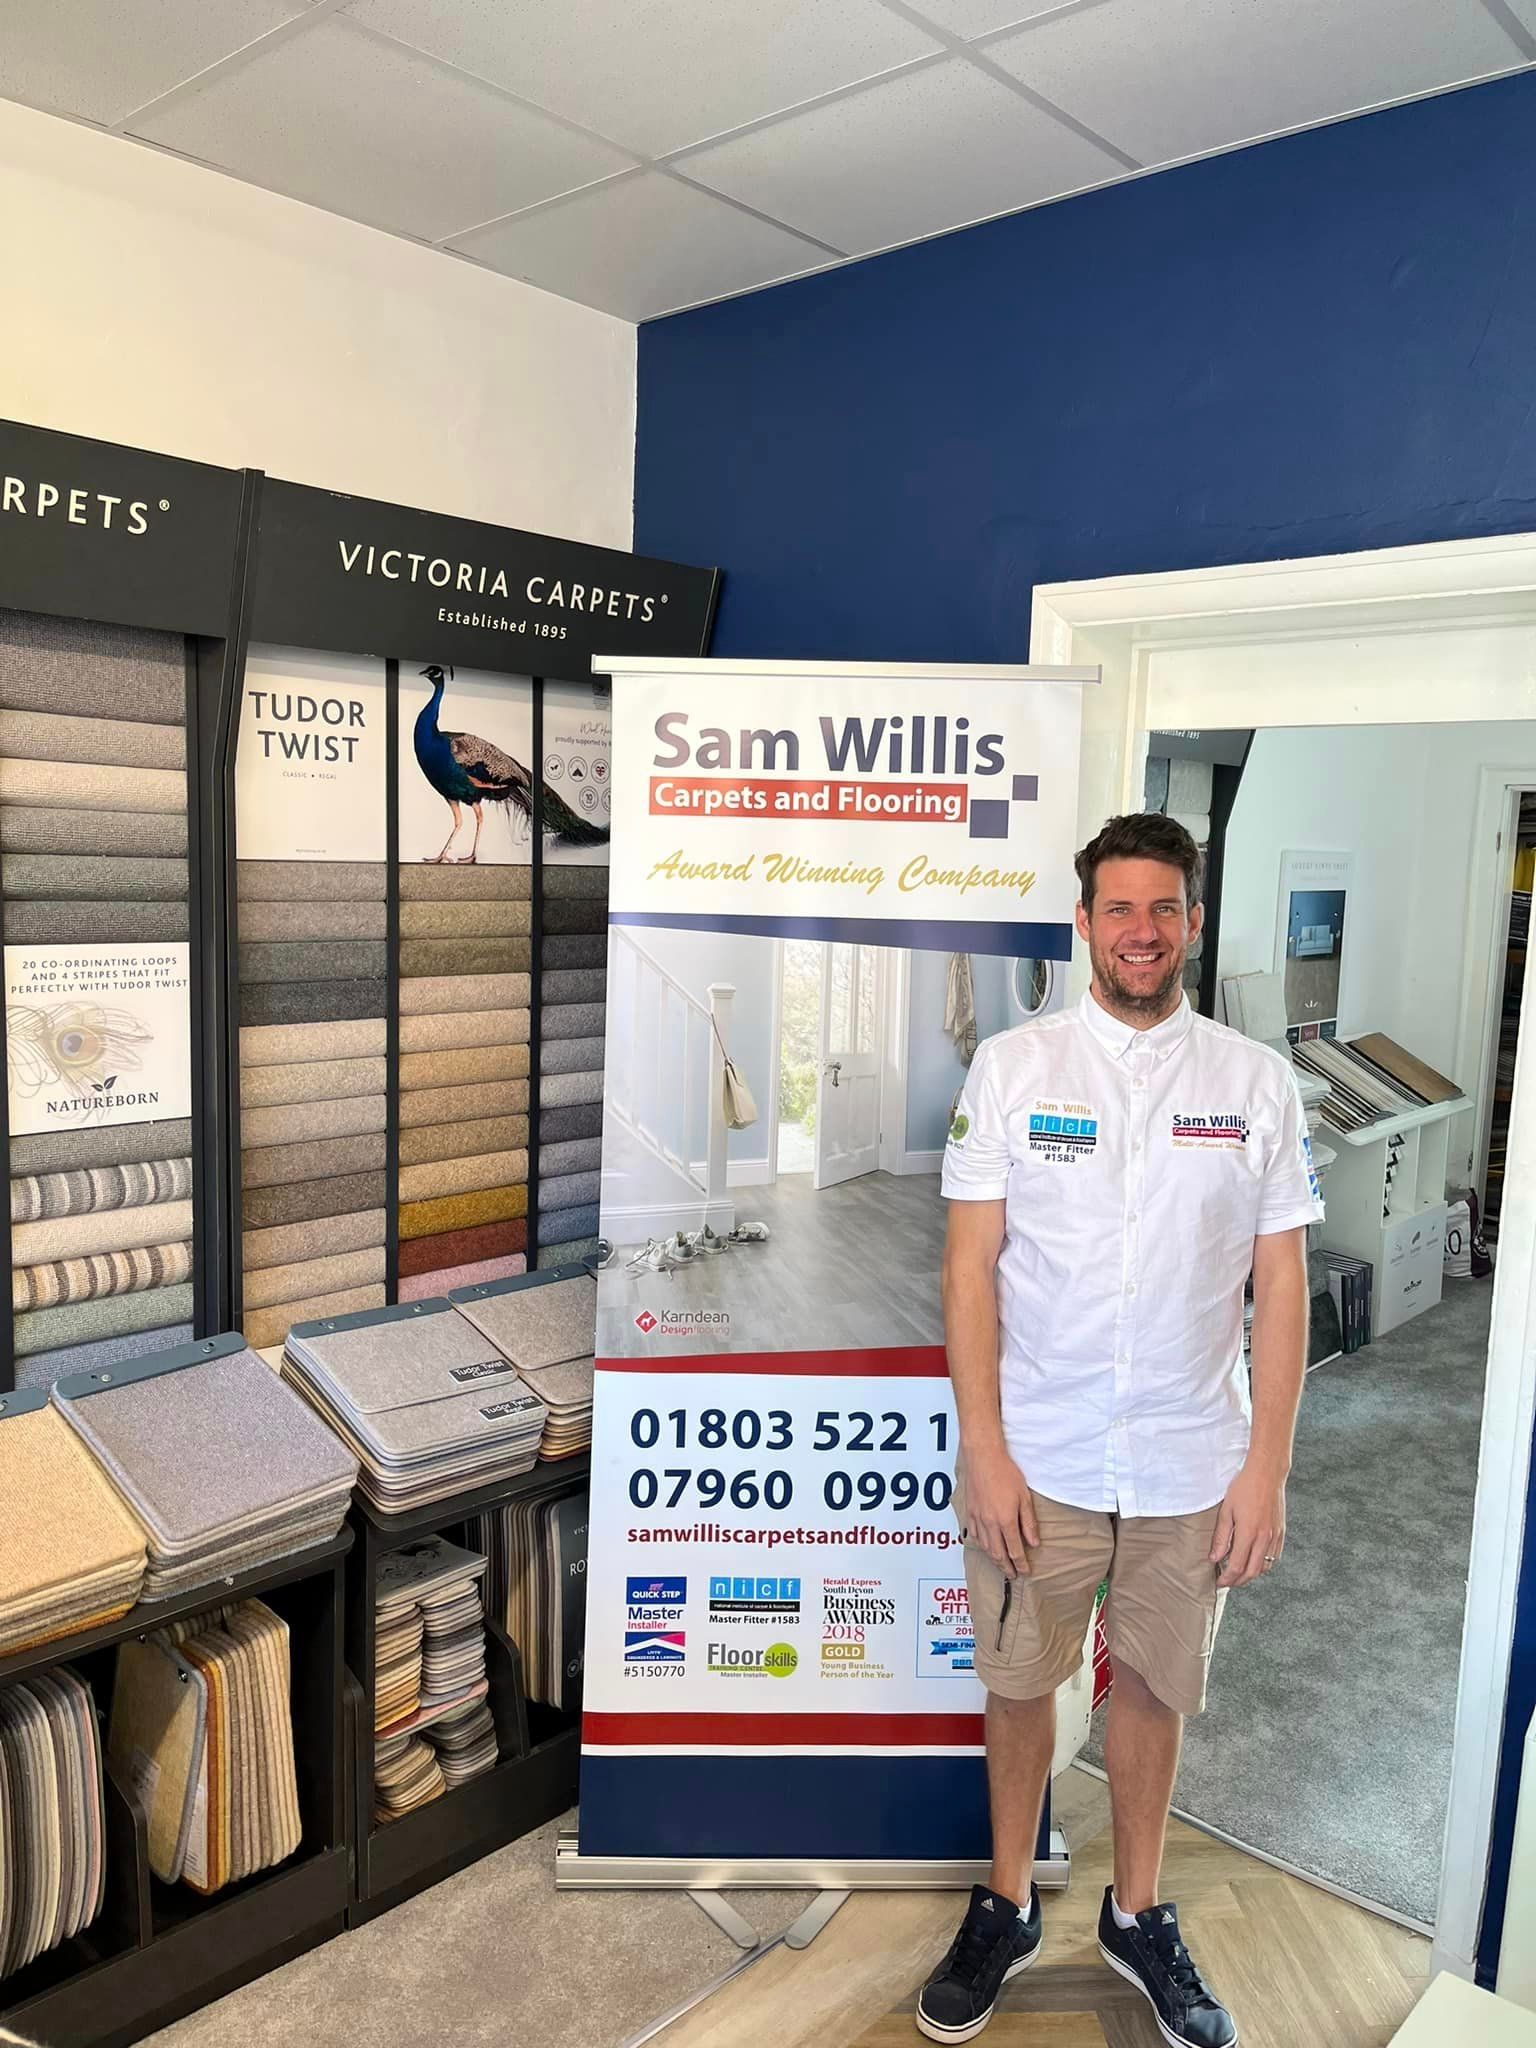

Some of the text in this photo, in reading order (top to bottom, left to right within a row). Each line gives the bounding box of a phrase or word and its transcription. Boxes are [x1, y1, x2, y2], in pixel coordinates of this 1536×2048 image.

[338, 540, 508, 598] VICTORIA
[437, 608, 568, 640] Established 1895
[248, 691, 365, 727] TUDOR
[257, 730, 359, 763] TWIST
[653, 712, 1006, 776] Sam Willis
[282, 771, 308, 779] CLASSIC
[654, 783, 962, 821] Carpets and Flooring
[647, 848, 1037, 898] Award Winning Company
[22, 957, 177, 969] 20 CO-ORDINATING LOOPS
[31, 972, 57, 981] AND
[73, 970, 118, 979] STRIPES
[123, 969, 149, 977] THAT
[154, 968, 170, 976] FIT
[11, 979, 187, 994] PERFECTLY WITH TUDOR TWIST
[46, 1092, 159, 1113] NATUREBORN
[1035, 1101, 1092, 1115] Sam Willis
[1032, 1118, 1093, 1133] nicf
[1173, 1114, 1247, 1129] Sam Willis
[1029, 1142, 1095, 1155] Master Fitter
[1044, 1153, 1076, 1163] #1583
[661, 1310, 730, 1323] Karndean
[455, 1361, 504, 1376] Tudor Twist
[483, 1397, 535, 1414] Tudor Twist
[630, 1408, 948, 1452] 01803 522 1
[628, 1468, 953, 1512] 07960 0990
[569, 1558, 588, 1577] RO
[714, 1579, 794, 1597] nicf
[823, 1578, 882, 1587] Herald Express
[823, 1586, 874, 1594] South Devon
[632, 1590, 681, 1599] QUICK STEP
[823, 1594, 895, 1610] Business
[628, 1606, 684, 1620] Master
[709, 1615, 800, 1625] Master Fitter #1583
[822, 1610, 895, 1625] AWARDS
[628, 1621, 667, 1630] Installer
[822, 1625, 865, 1643] 2018
[825, 1646, 861, 1657] GOLD
[624, 1665, 686, 1678] #5150770
[821, 1662, 884, 1670] Young Business
[850, 1670, 859, 1678] of
[877, 1671, 894, 1679] Year
